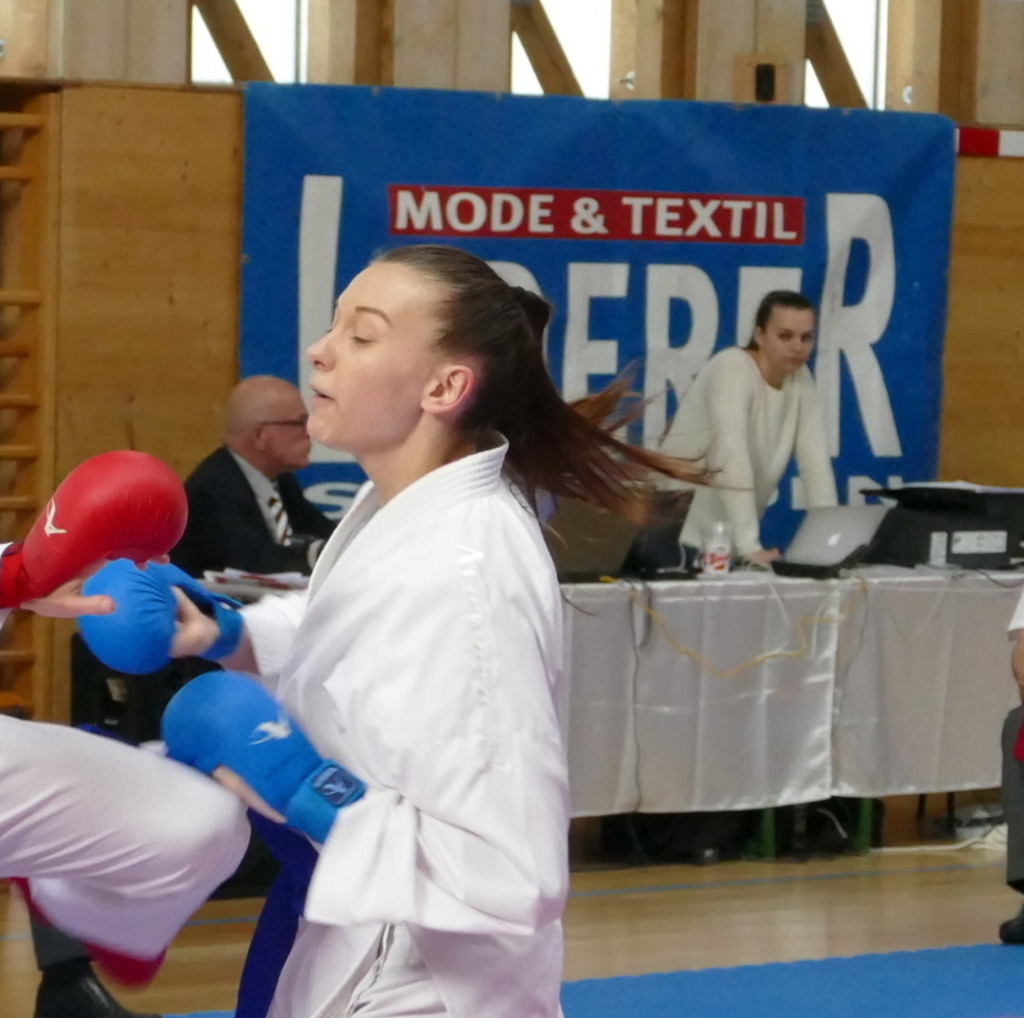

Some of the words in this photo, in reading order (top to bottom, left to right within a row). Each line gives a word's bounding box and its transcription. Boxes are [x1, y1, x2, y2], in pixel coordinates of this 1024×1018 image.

[395, 190, 554, 233] MODE
[570, 197, 609, 235] &
[621, 196, 798, 239] TEXTIL
